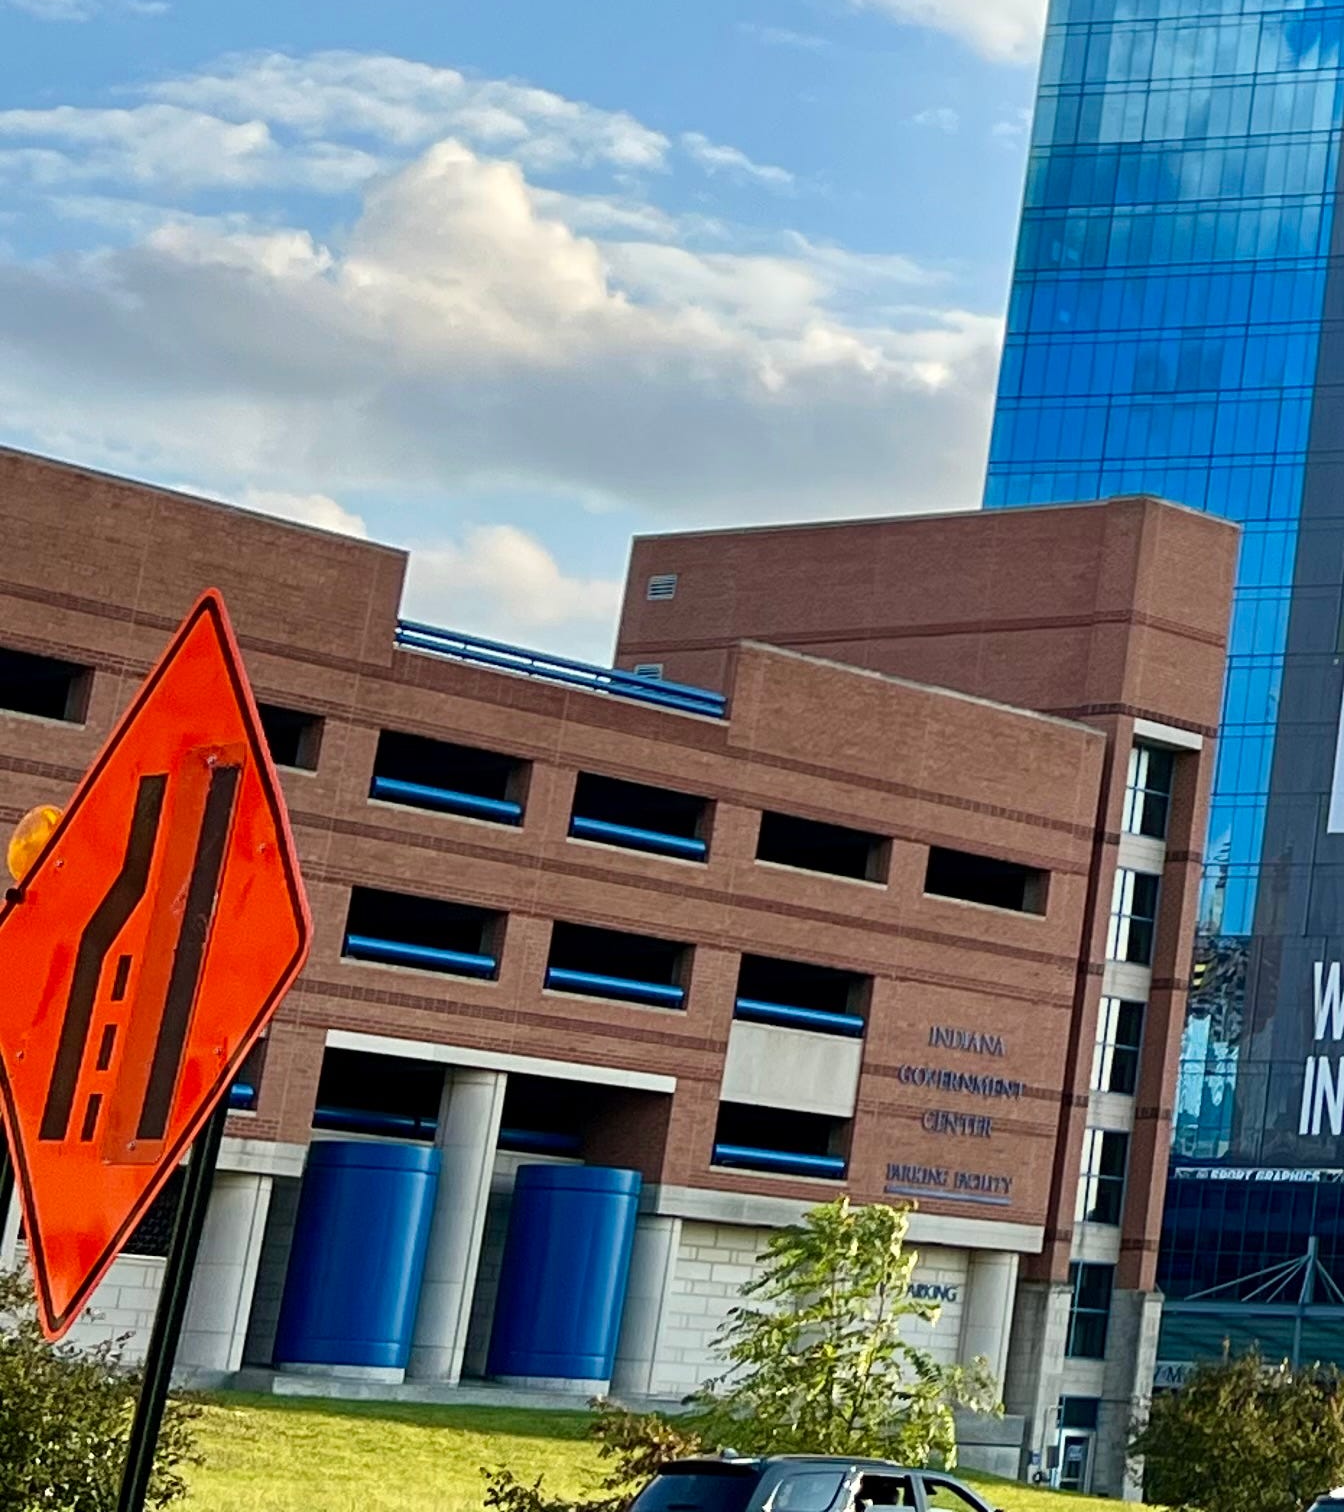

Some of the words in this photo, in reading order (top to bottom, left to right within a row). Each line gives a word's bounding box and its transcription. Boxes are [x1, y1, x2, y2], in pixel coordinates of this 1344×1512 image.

[928, 1025, 1008, 1058] INDIANA
[898, 1064, 1027, 1101] GOVERNMENT
[921, 1109, 993, 1139] CENTER
[886, 1162, 948, 1187] PARKING
[897, 1283, 959, 1303] ARKING
